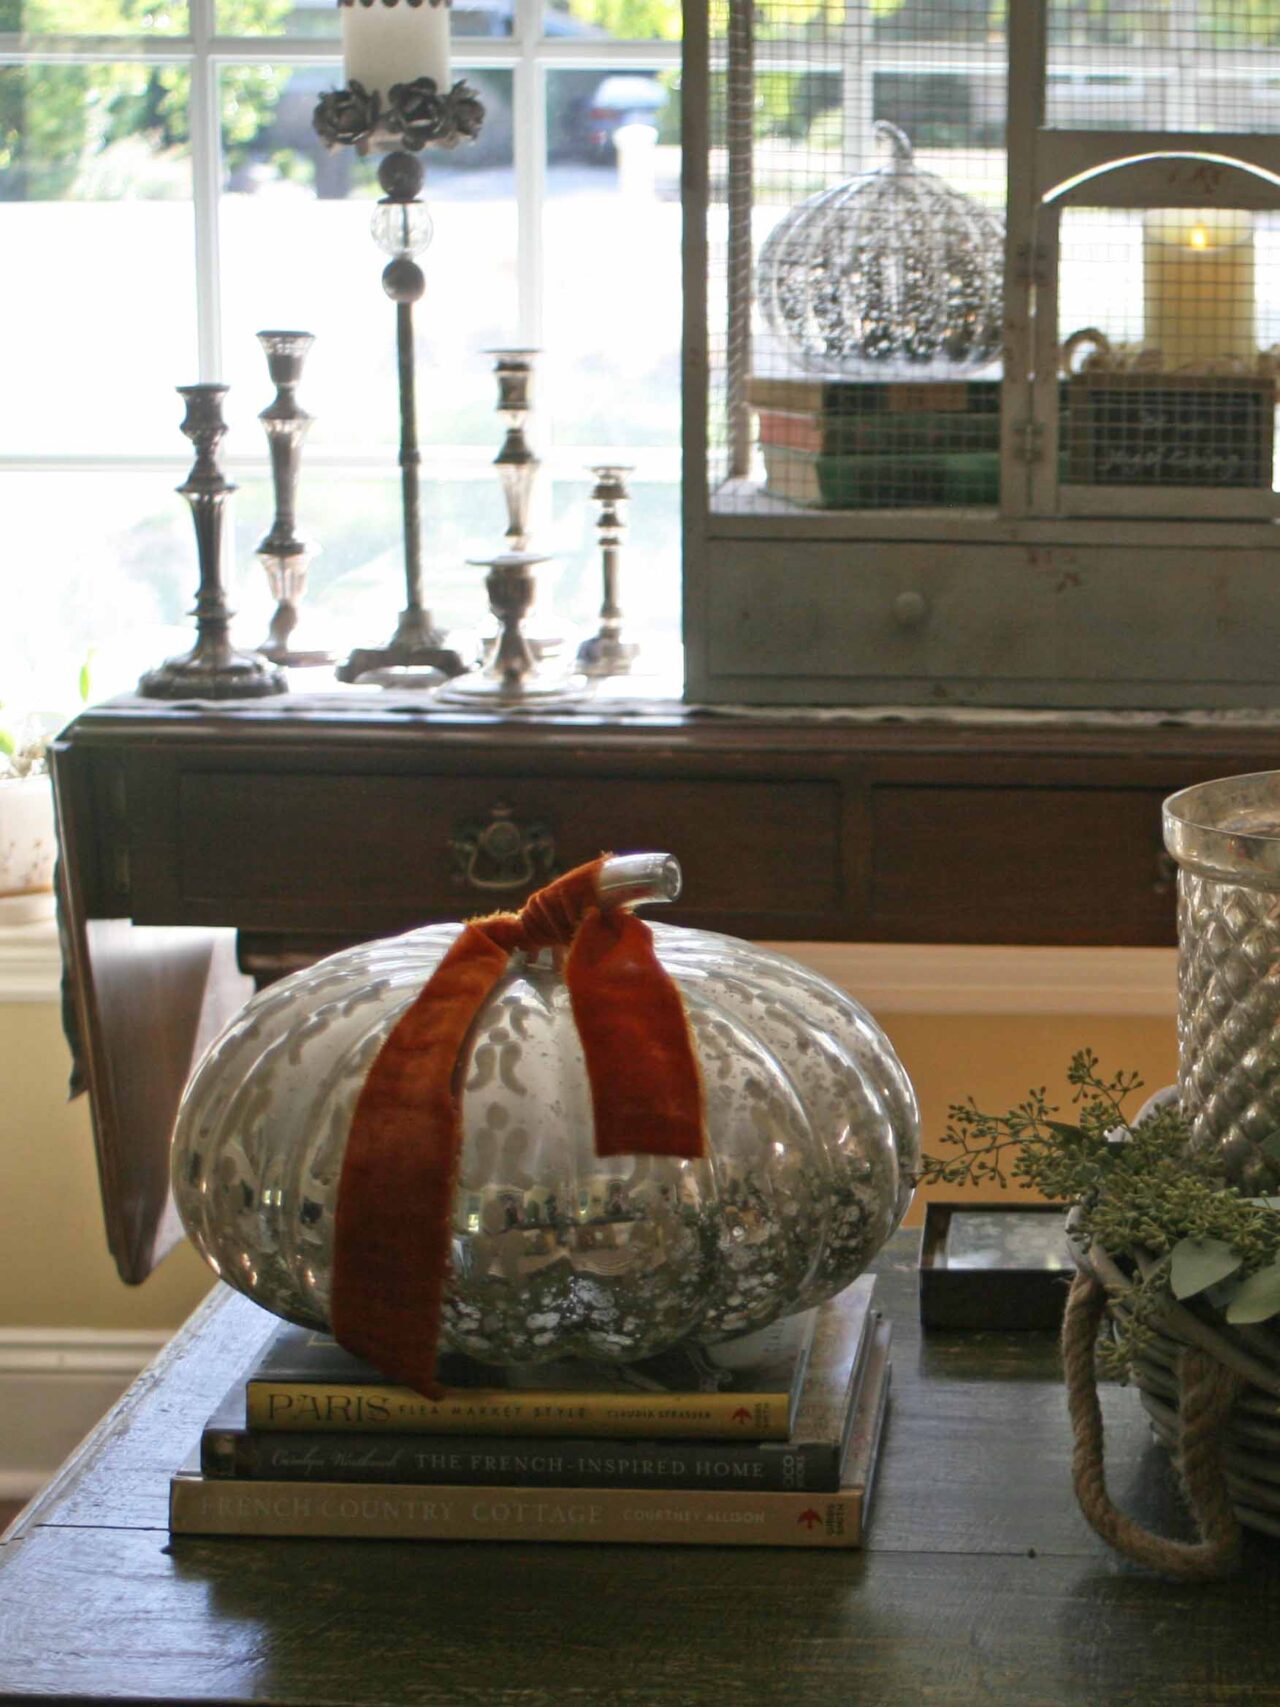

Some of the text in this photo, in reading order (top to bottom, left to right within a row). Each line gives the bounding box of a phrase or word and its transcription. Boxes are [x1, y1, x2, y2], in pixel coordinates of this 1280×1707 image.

[268, 1393, 587, 1422] PARIS FLEA MARKET STYLE
[415, 1453, 765, 1478] THE FRENCH-INSPIRED HOME
[201, 1496, 605, 1524] FRENCH COUNTRY COTTAGE
[622, 1509, 766, 1524] COURTNEY ALLISON
